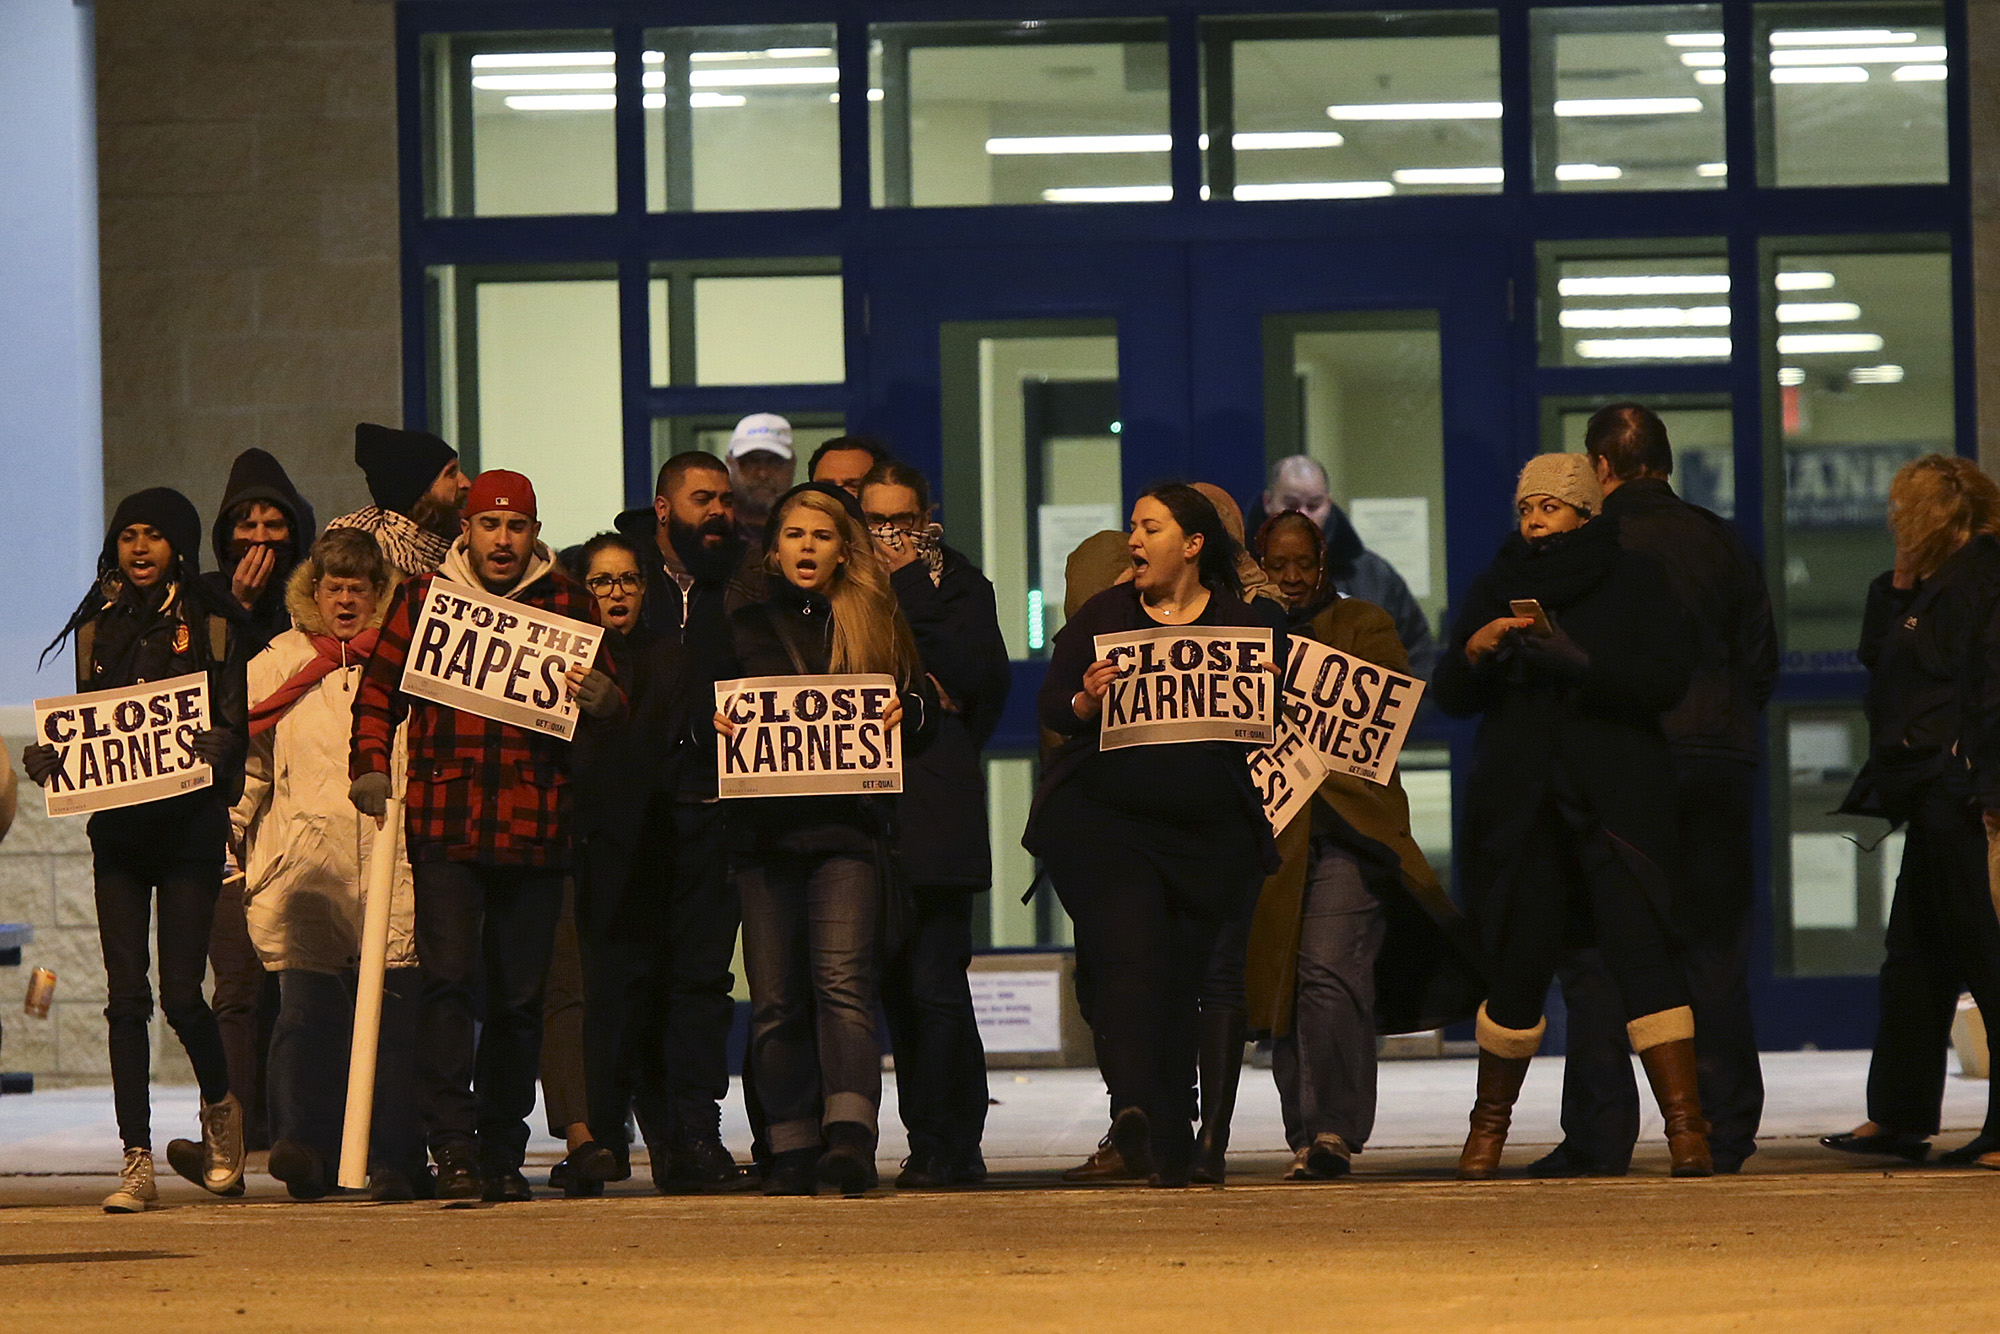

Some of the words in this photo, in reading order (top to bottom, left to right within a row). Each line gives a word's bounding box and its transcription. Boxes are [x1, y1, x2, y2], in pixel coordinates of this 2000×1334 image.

[431, 593, 518, 634] STOP
[526, 622, 593, 659] THE
[1106, 639, 1266, 679] CLOSE
[1283, 634, 1412, 730] LOSE
[44, 687, 202, 743] CLOSE
[723, 688, 891, 724] CLOSE
[1107, 673, 1266, 727] KARNES!
[52, 722, 205, 793] KARNES
[725, 723, 893, 774] KARNES!
[1282, 696, 1391, 767] RNES!
